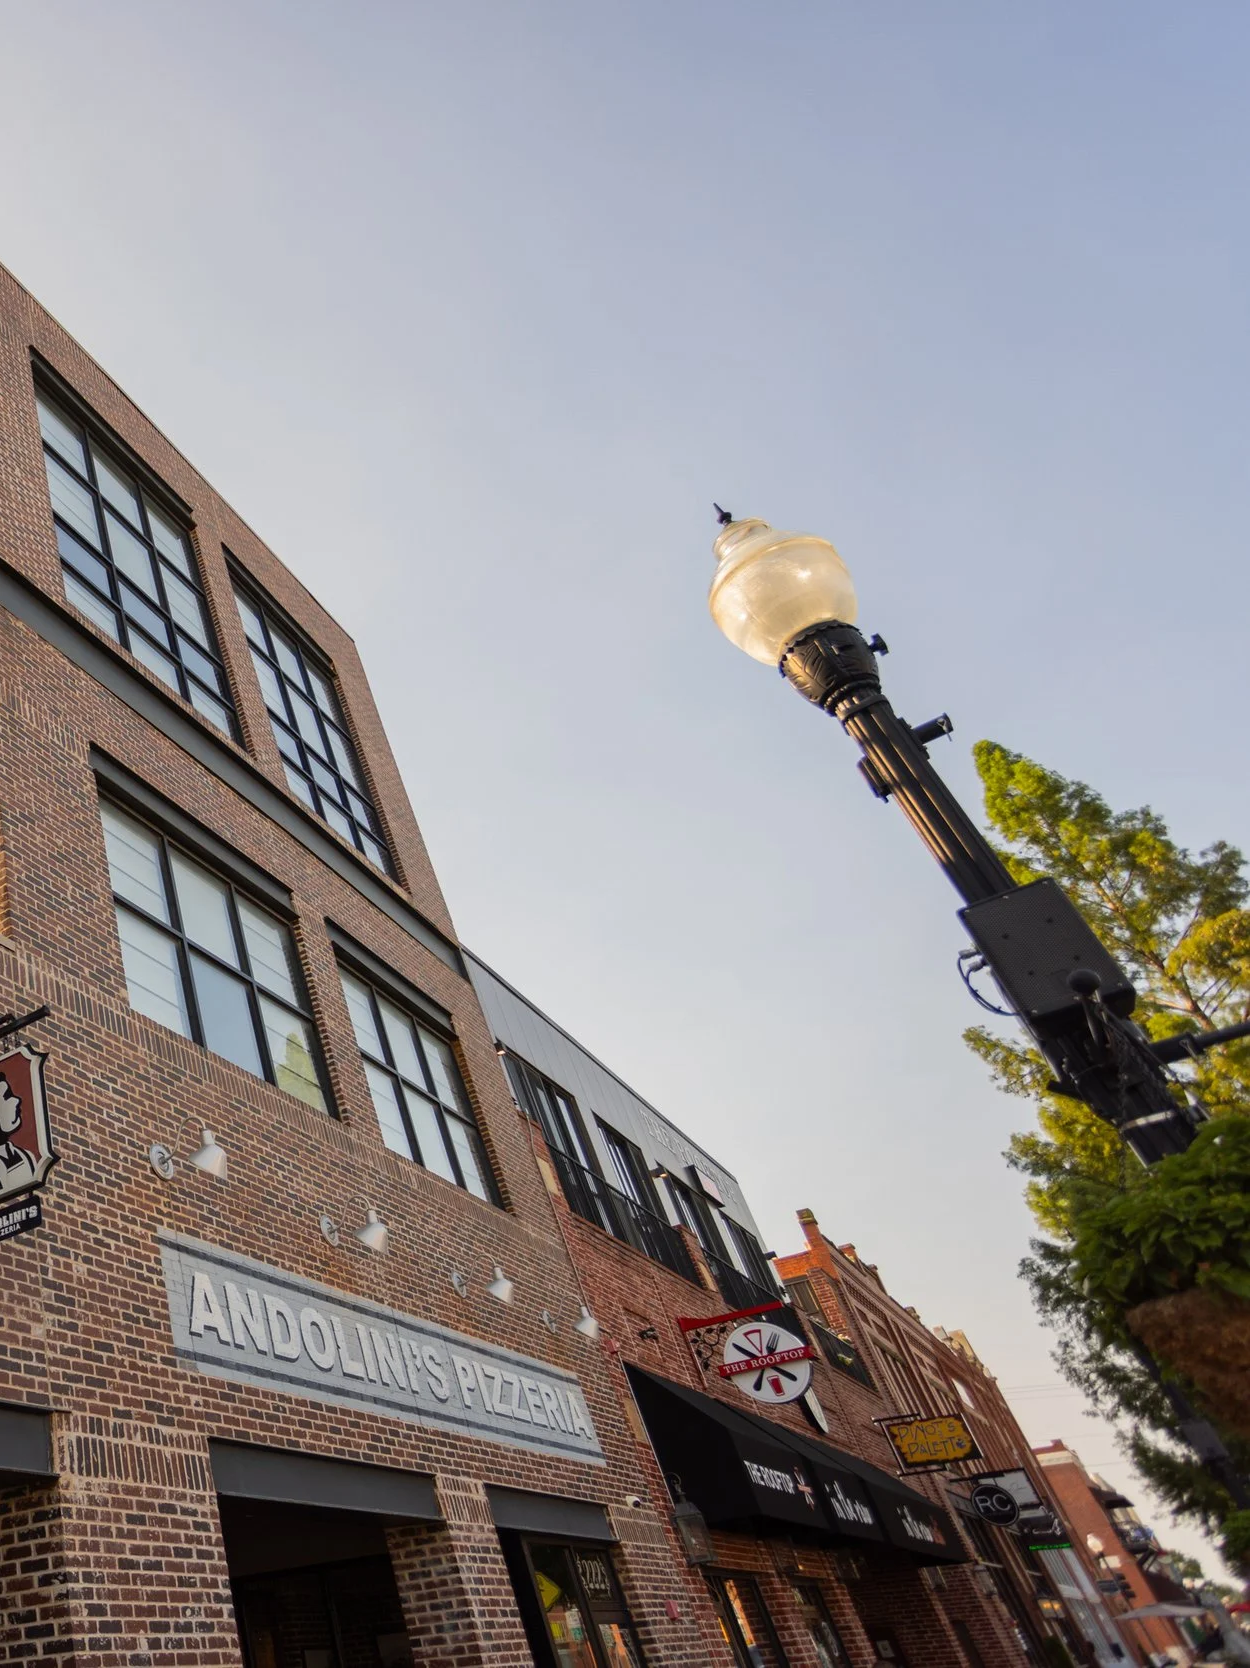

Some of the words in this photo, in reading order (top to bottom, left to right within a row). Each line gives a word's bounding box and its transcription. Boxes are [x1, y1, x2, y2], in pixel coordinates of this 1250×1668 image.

[189, 1271, 450, 1402] ANDOLINI'S
[451, 1354, 593, 1441] PIZZERIA
[723, 1363, 748, 1374] THE
[751, 1349, 805, 1368] ROOFTOP
[974, 1493, 1012, 1514] RC
